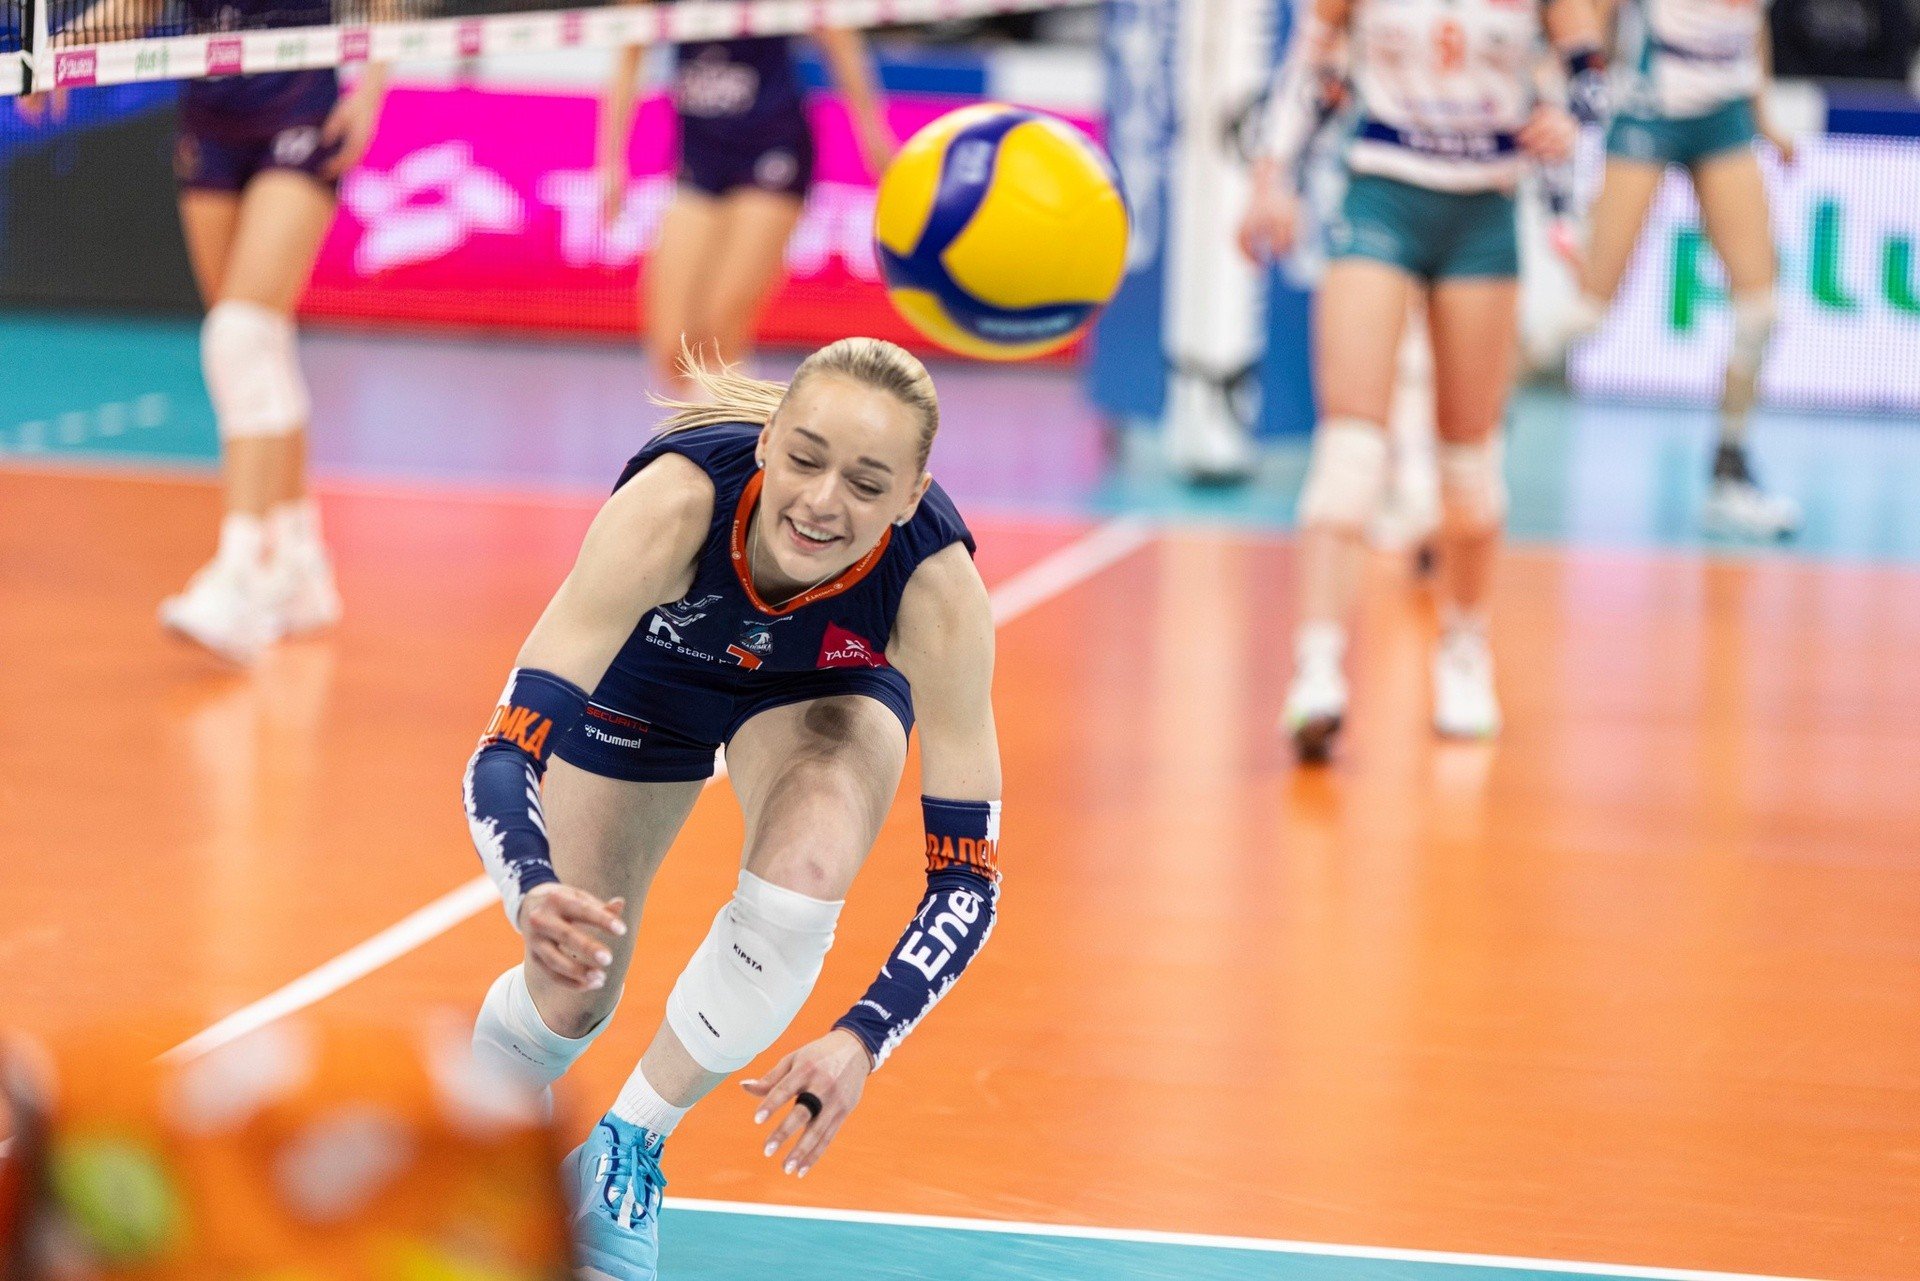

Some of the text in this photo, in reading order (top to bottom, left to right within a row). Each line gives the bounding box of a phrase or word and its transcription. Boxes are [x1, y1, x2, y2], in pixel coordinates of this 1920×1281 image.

[824, 649, 875, 667] TAUR
[595, 728, 642, 749] hummel
[896, 889, 985, 982] Ene
[732, 942, 763, 972] KIPSTA
